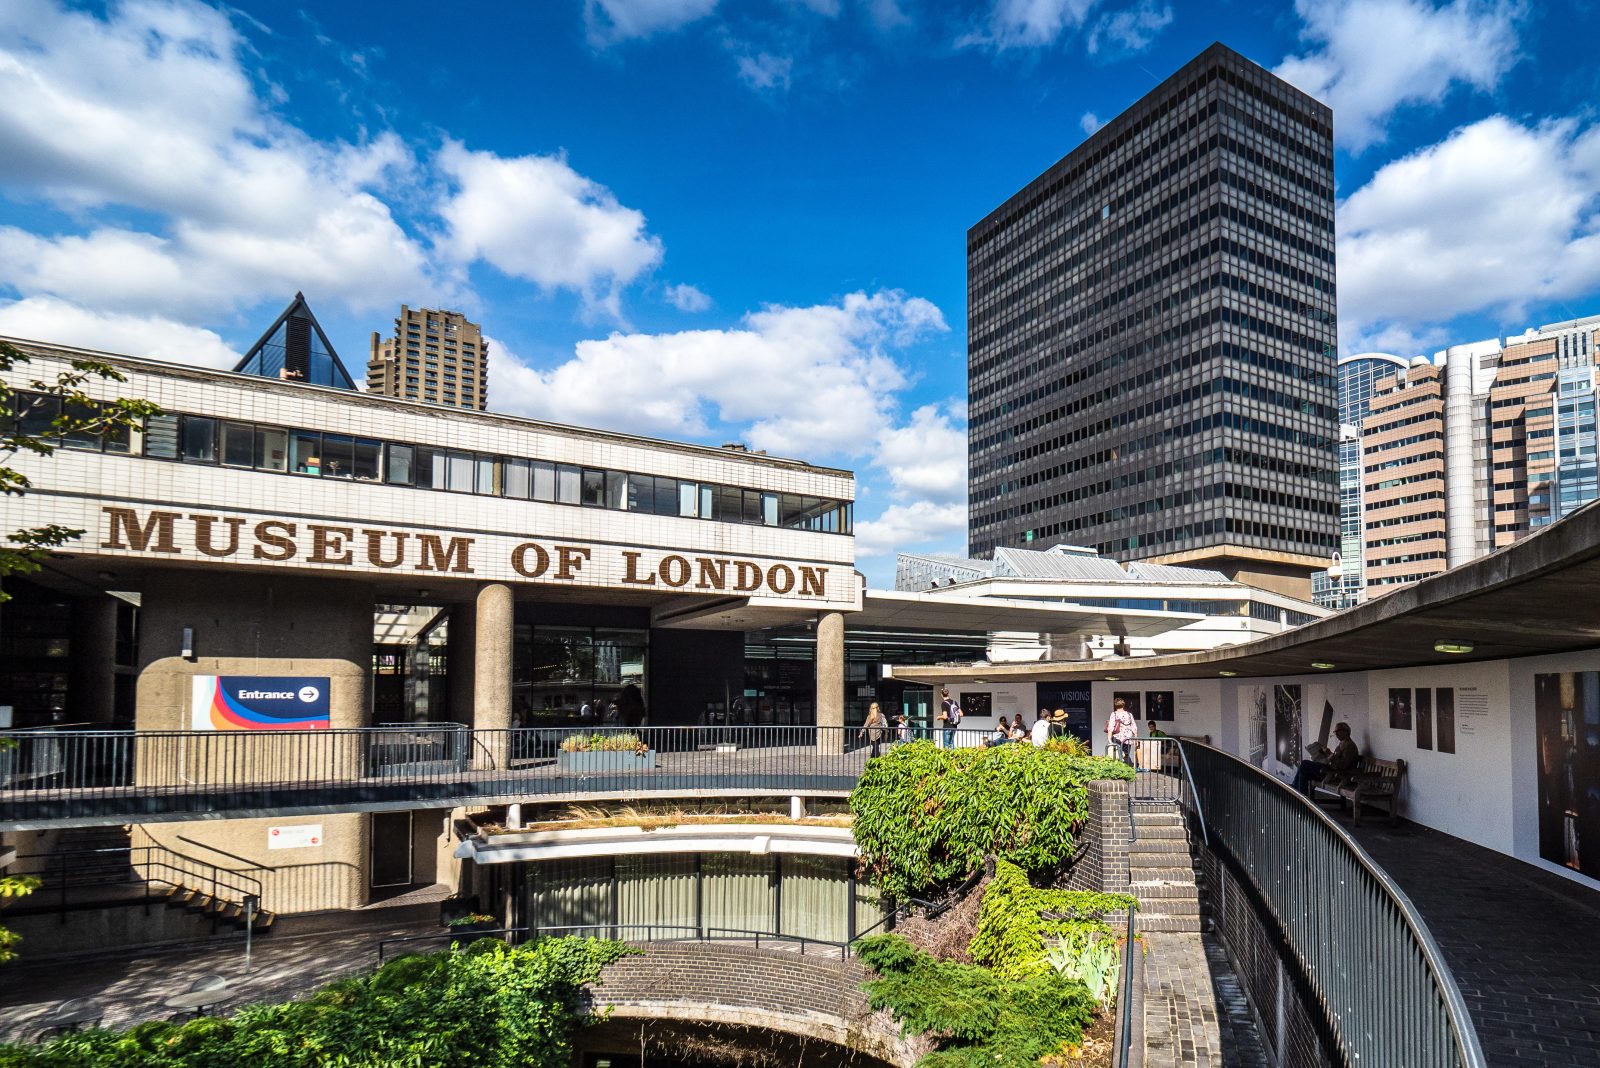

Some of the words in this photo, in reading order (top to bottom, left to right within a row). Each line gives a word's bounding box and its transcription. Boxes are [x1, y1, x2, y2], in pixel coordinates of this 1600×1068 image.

[101, 507, 475, 574] MUSEUM
[511, 542, 591, 580] OF
[622, 551, 828, 595] LONDON
[238, 689, 295, 700] Entrance
[1060, 690, 1090, 702] VISIONS
